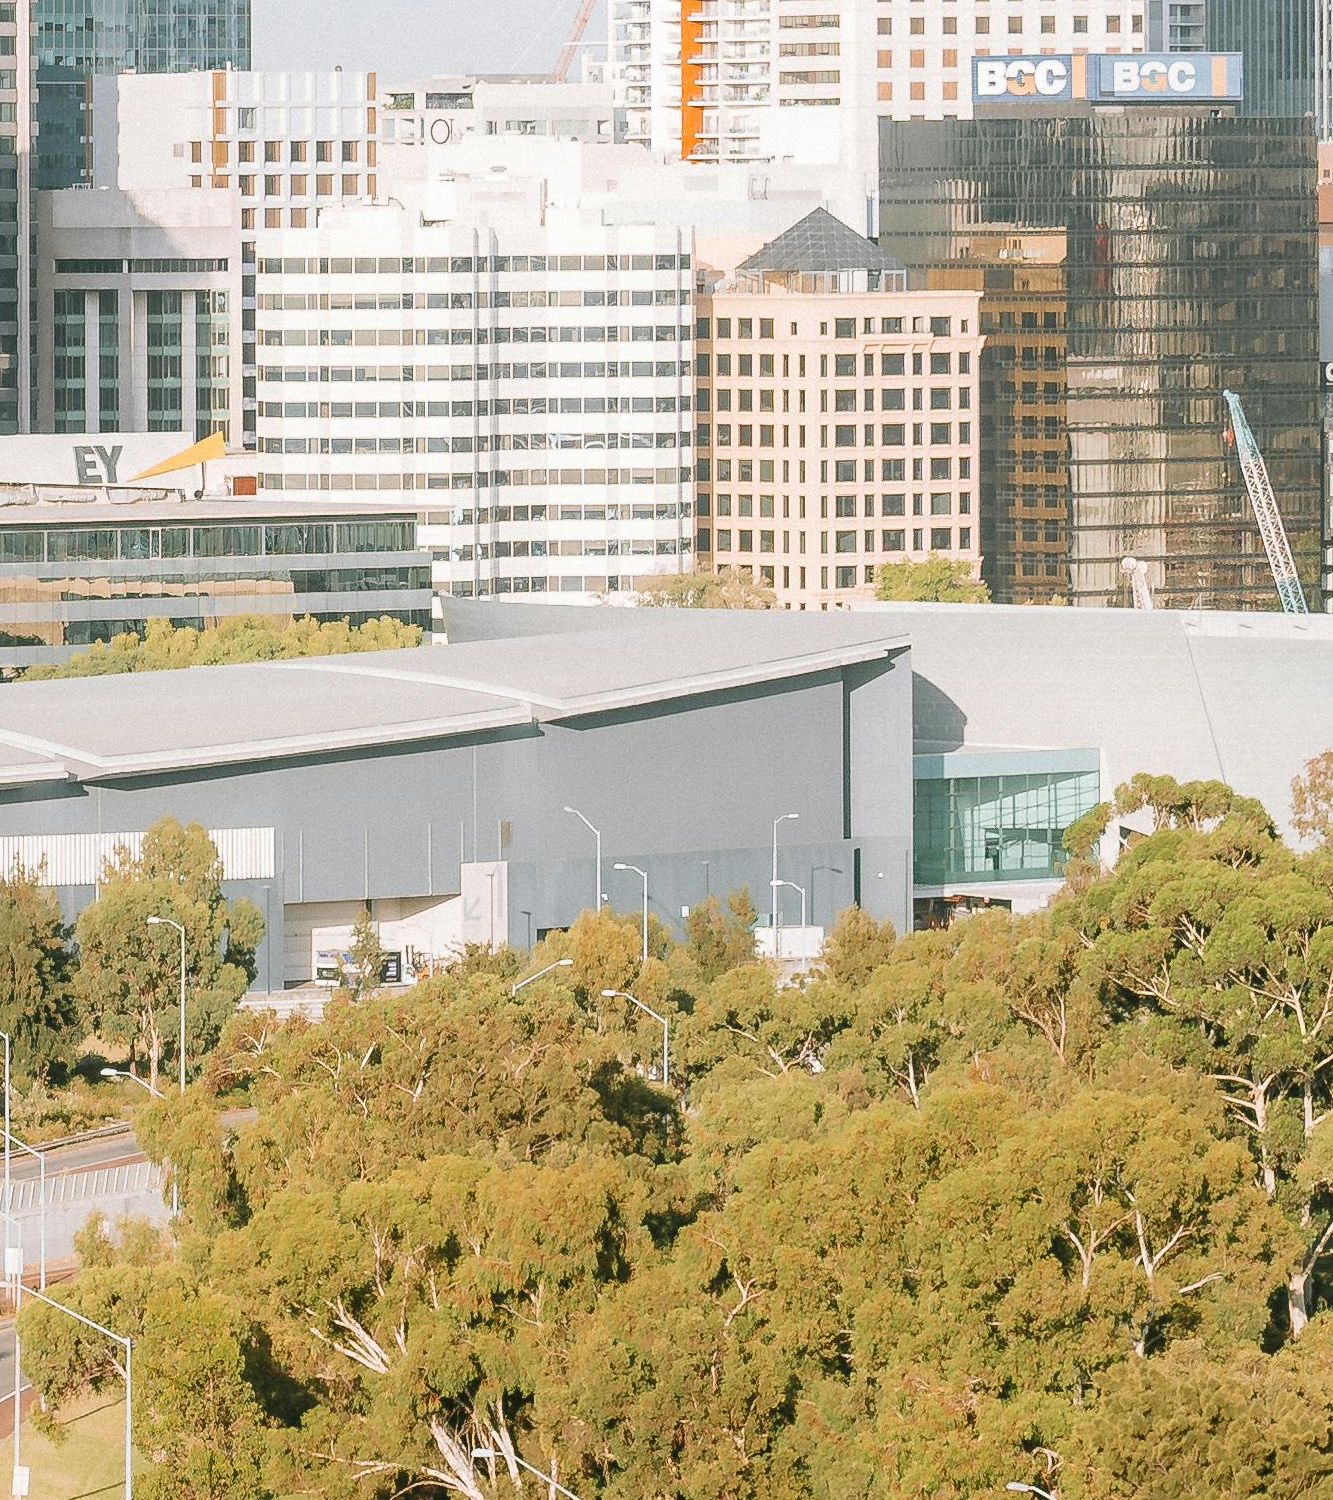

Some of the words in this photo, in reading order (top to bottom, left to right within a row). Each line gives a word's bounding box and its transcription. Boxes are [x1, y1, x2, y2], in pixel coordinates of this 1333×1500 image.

[977, 59, 1070, 96] BGC
[1114, 61, 1196, 92] BGC
[74, 445, 123, 483] EY
